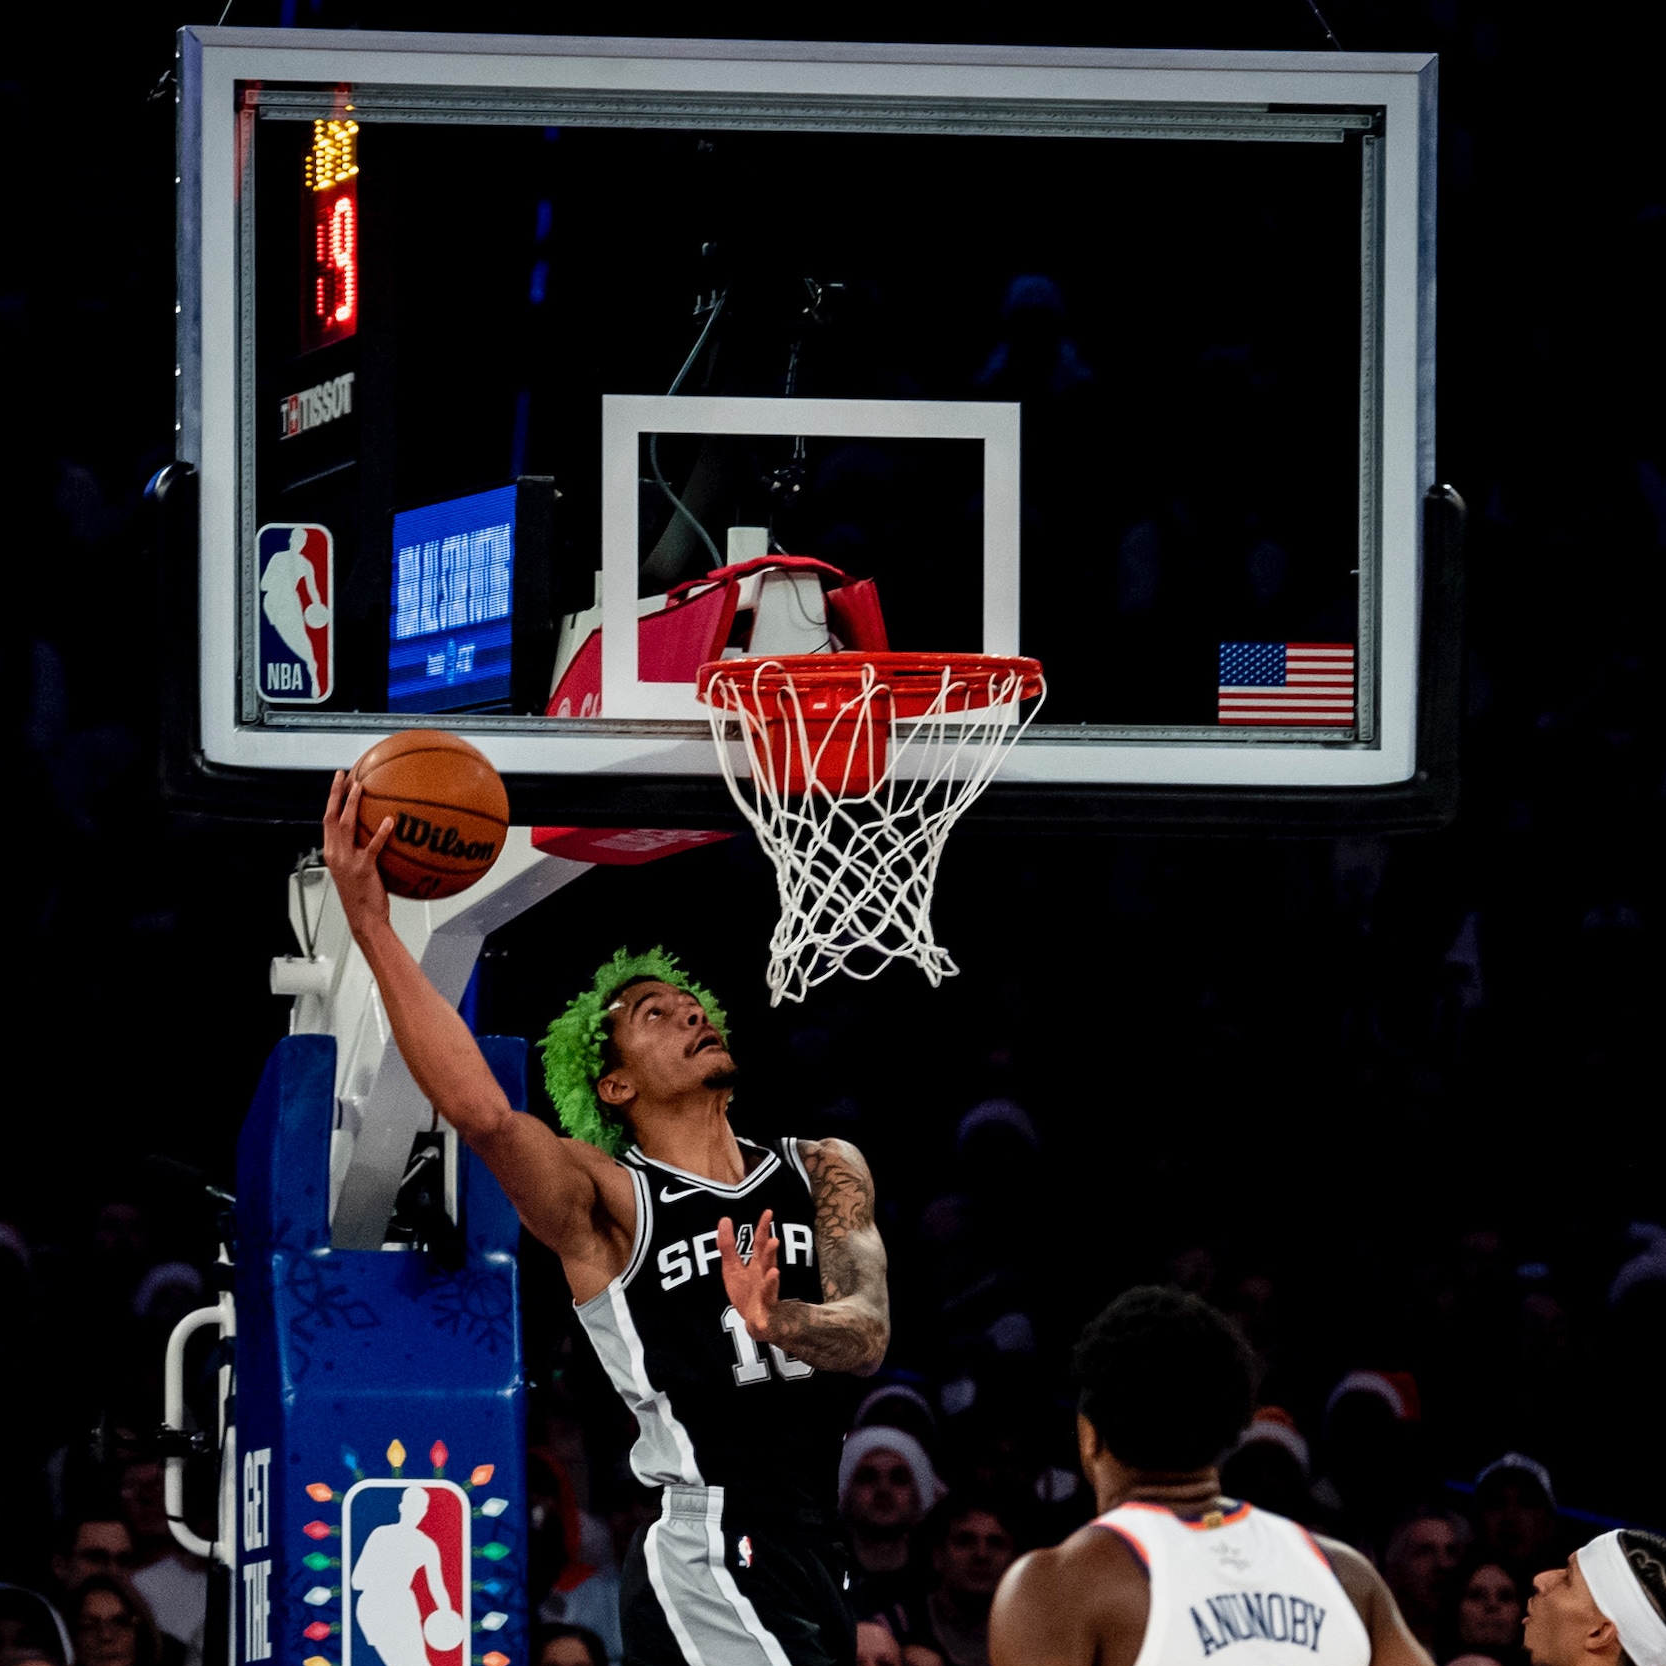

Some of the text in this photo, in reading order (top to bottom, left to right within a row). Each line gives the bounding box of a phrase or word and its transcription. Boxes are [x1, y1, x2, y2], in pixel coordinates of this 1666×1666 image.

[266, 662, 304, 691] NBA
[395, 811, 495, 862] Wilson
[243, 1447, 272, 1552] GET
[243, 1559, 272, 1663] THE
[1189, 1591, 1326, 1657] ANUNOBY
